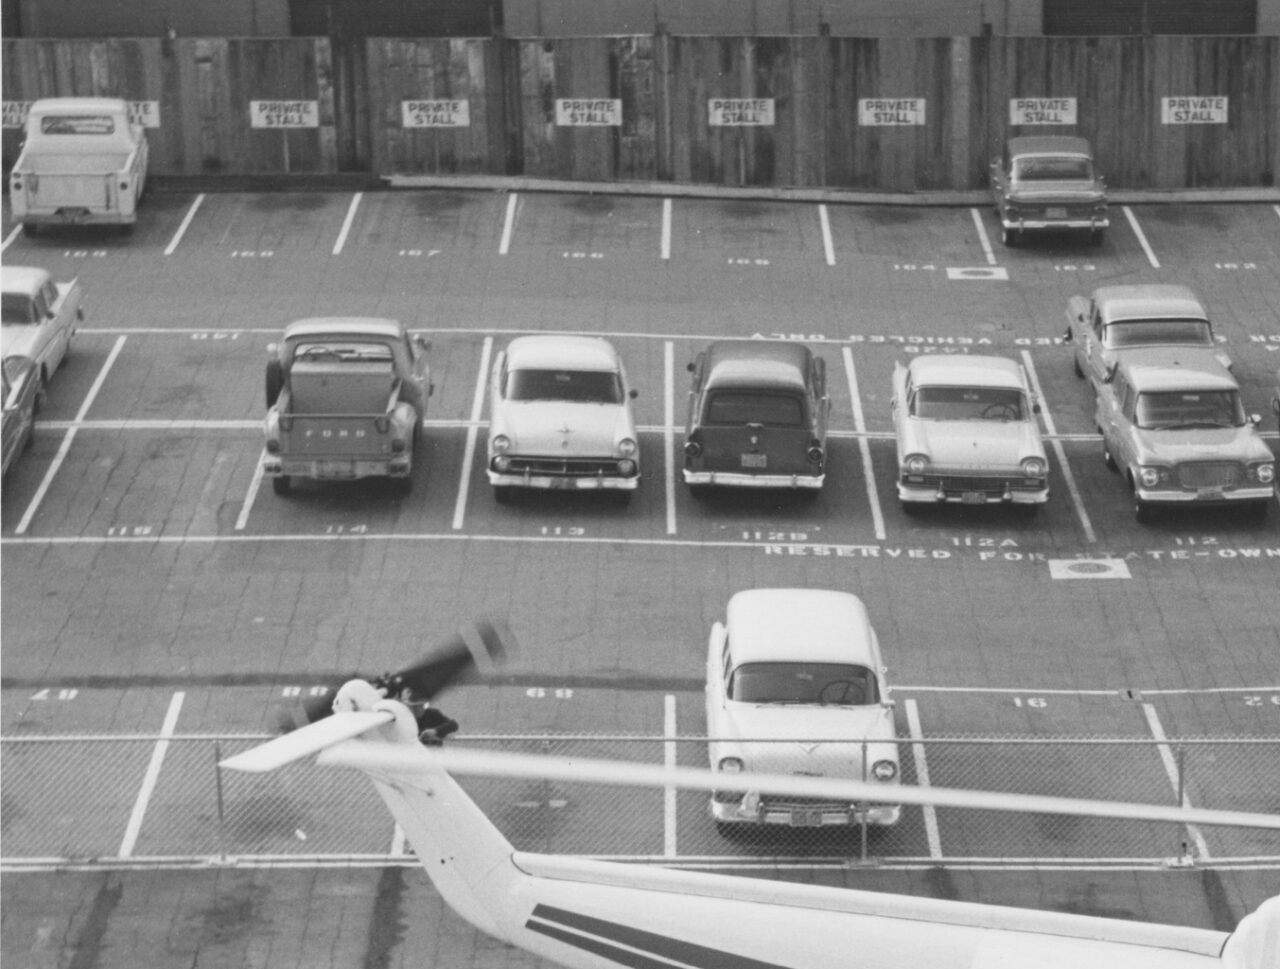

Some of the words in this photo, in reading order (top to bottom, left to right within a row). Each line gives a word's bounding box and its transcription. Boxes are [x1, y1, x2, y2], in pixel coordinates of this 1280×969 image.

[259, 103, 311, 114] PRIVATE
[408, 101, 459, 113] PRIVATE
[563, 100, 614, 112] PRIVATE
[714, 100, 766, 111] PRIVATE
[866, 100, 917, 111] PRIVATE
[1017, 99, 1068, 111] PRIVATE
[1168, 98, 1223, 110] PRIVATE
[265, 114, 306, 125] STALL
[415, 113, 455, 124] STALL
[570, 112, 608, 123] STALL
[722, 111, 760, 123] STALL
[874, 111, 914, 123] STALL
[1024, 111, 1062, 122] STALL
[1175, 110, 1214, 122] STALL
[749, 332, 825, 341] ONLY
[850, 334, 992, 344] VEHICLES
[306, 430, 366, 438] FORD
[326, 524, 368, 533] 114
[541, 526, 585, 535] 113
[742, 531, 808, 541] 112B
[952, 536, 1018, 546] 112A
[1175, 536, 1219, 545] 112
[764, 546, 951, 559] RESERVED
[978, 551, 1045, 562] FOR
